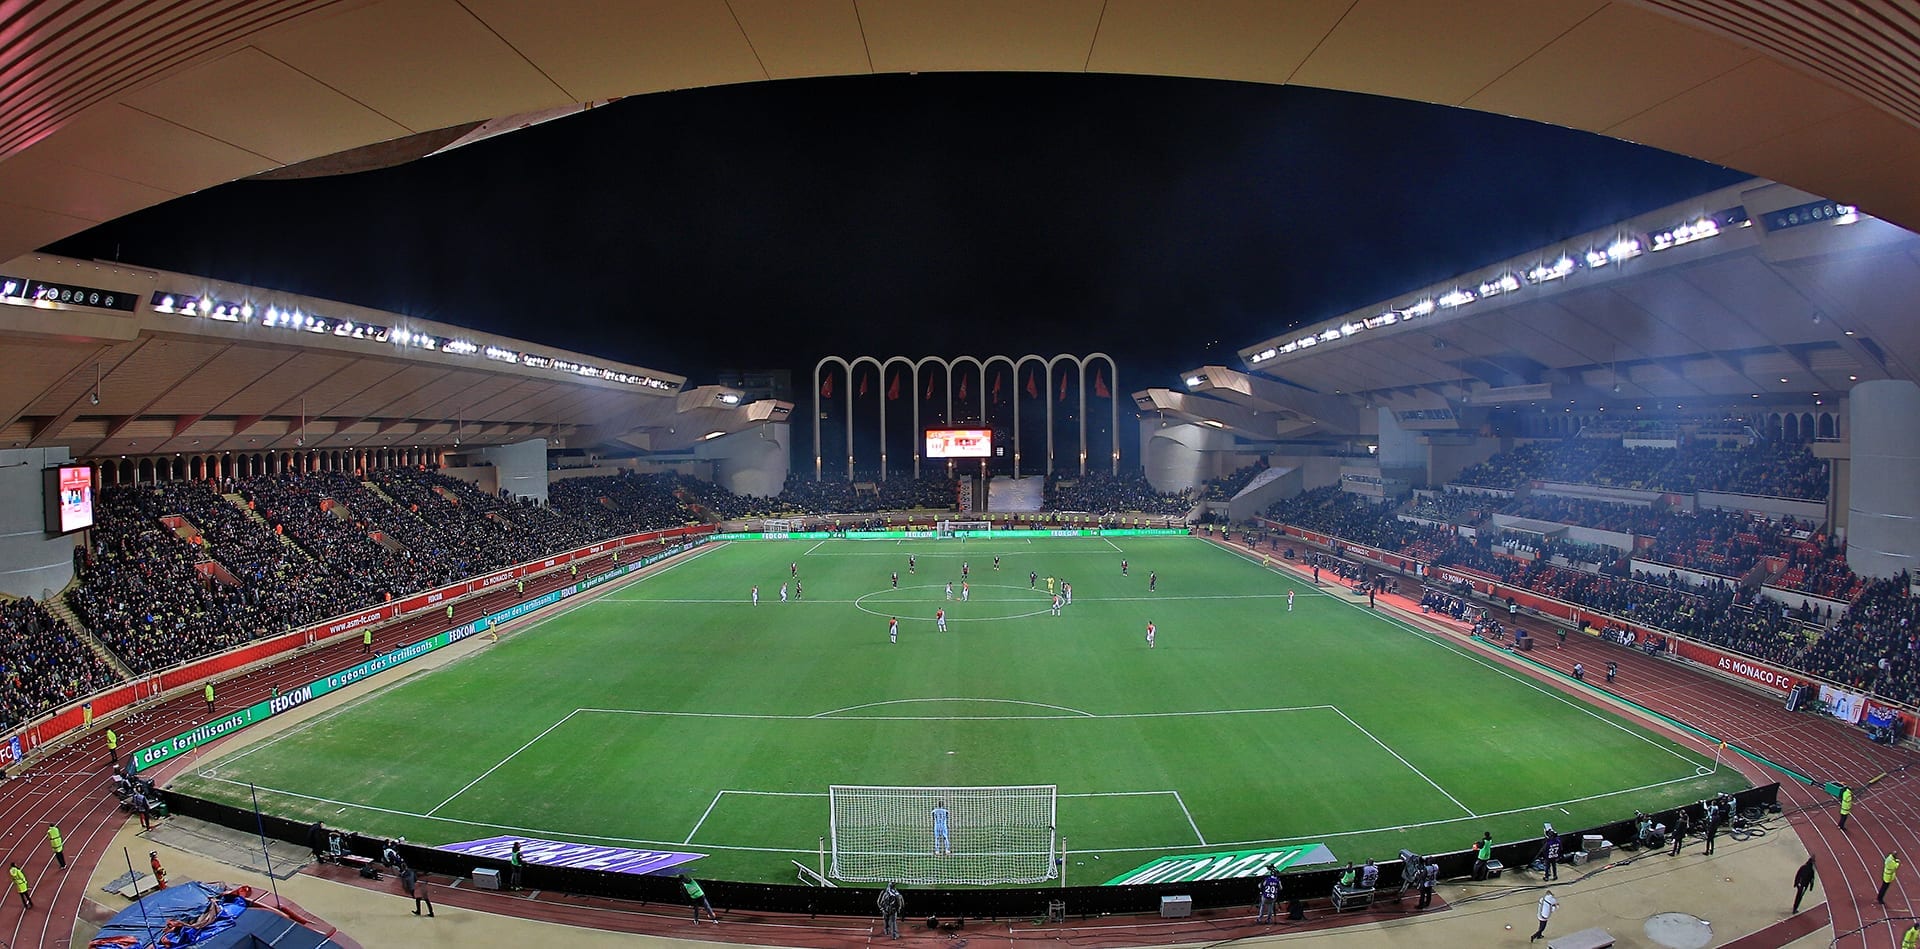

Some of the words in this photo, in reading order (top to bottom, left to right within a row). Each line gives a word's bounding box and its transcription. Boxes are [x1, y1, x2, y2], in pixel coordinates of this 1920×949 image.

[330, 612, 381, 634] www.asm-fc.com
[449, 623, 476, 642] FEDCOM
[328, 677, 337, 688] le
[341, 666, 368, 685] géant
[371, 658, 386, 673] des
[388, 640, 433, 664] fertilisants
[1719, 657, 1730, 669] AS
[1733, 661, 1773, 683] MONACO
[1776, 675, 1789, 688] FC
[270, 686, 312, 714] FEDCOM
[144, 745, 168, 763] des
[172, 714, 243, 750] fertilisants
[0, 745, 12, 763] FC
